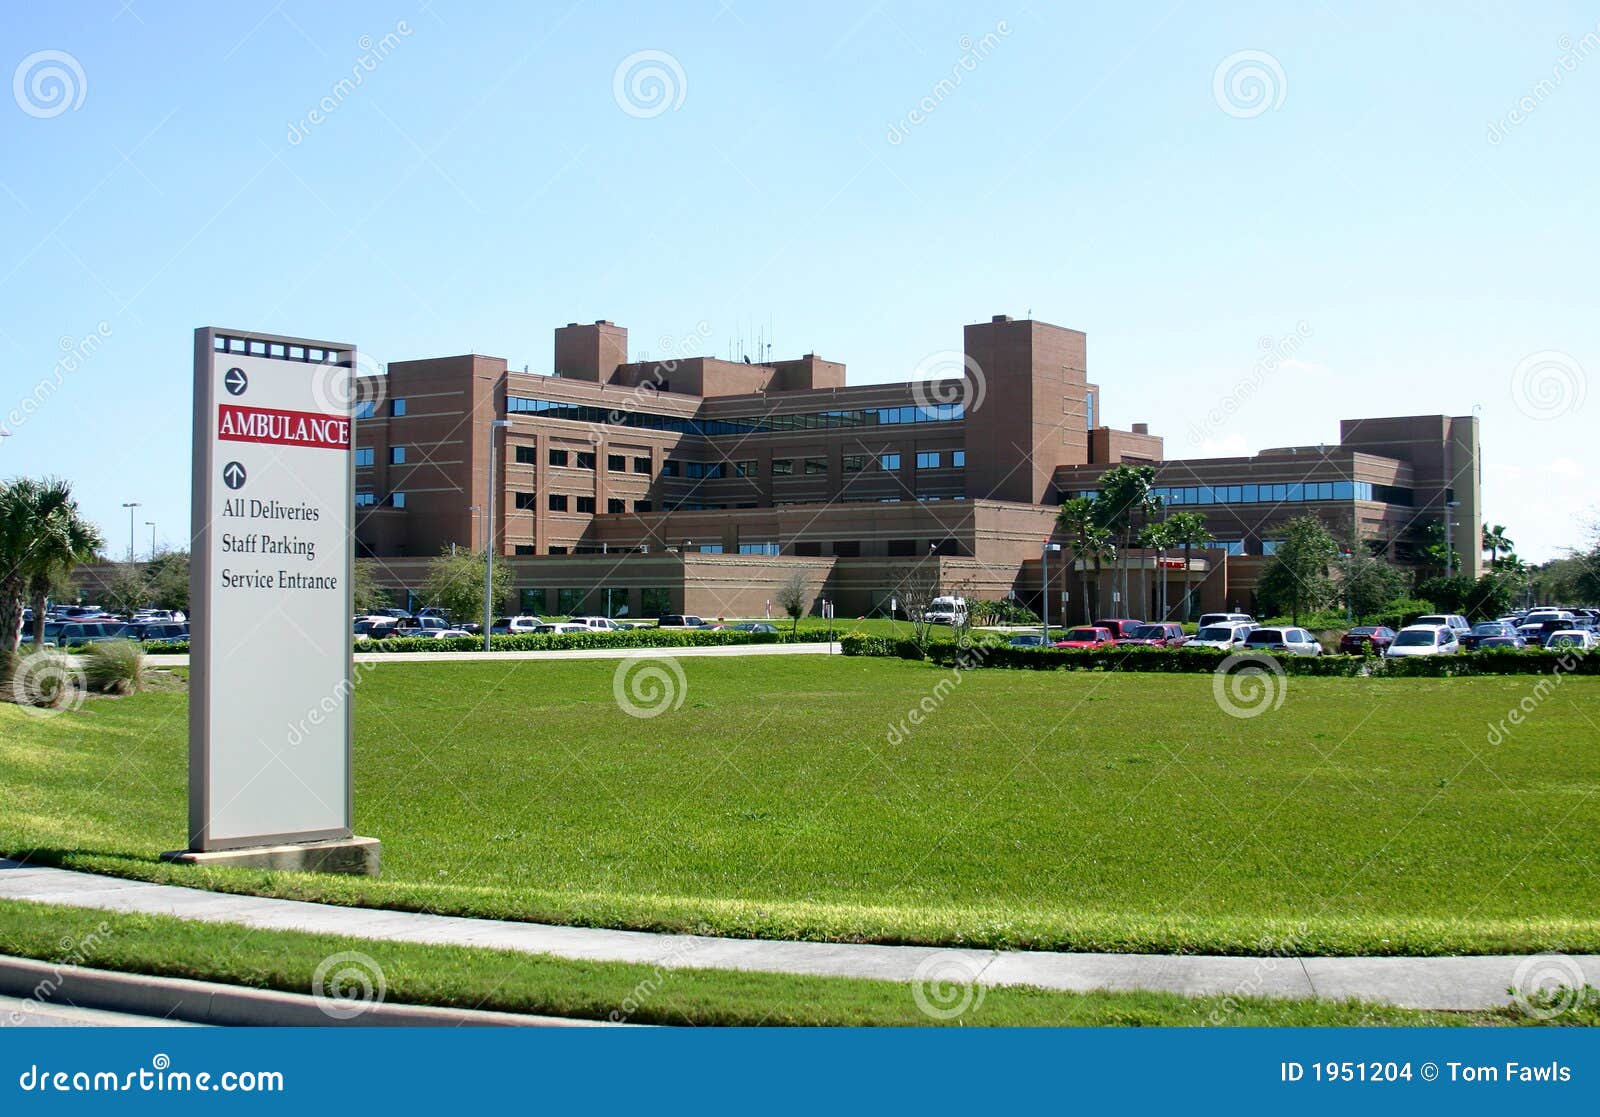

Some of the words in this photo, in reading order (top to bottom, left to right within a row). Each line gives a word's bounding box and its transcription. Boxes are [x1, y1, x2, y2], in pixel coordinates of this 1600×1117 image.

[221, 412, 348, 444] AMBULANCE
[222, 498, 245, 517] All
[250, 500, 319, 521] Deliveries
[222, 533, 257, 553] Staff
[261, 535, 315, 561] Parking
[222, 569, 274, 589] Service
[279, 570, 337, 590] Entrance
